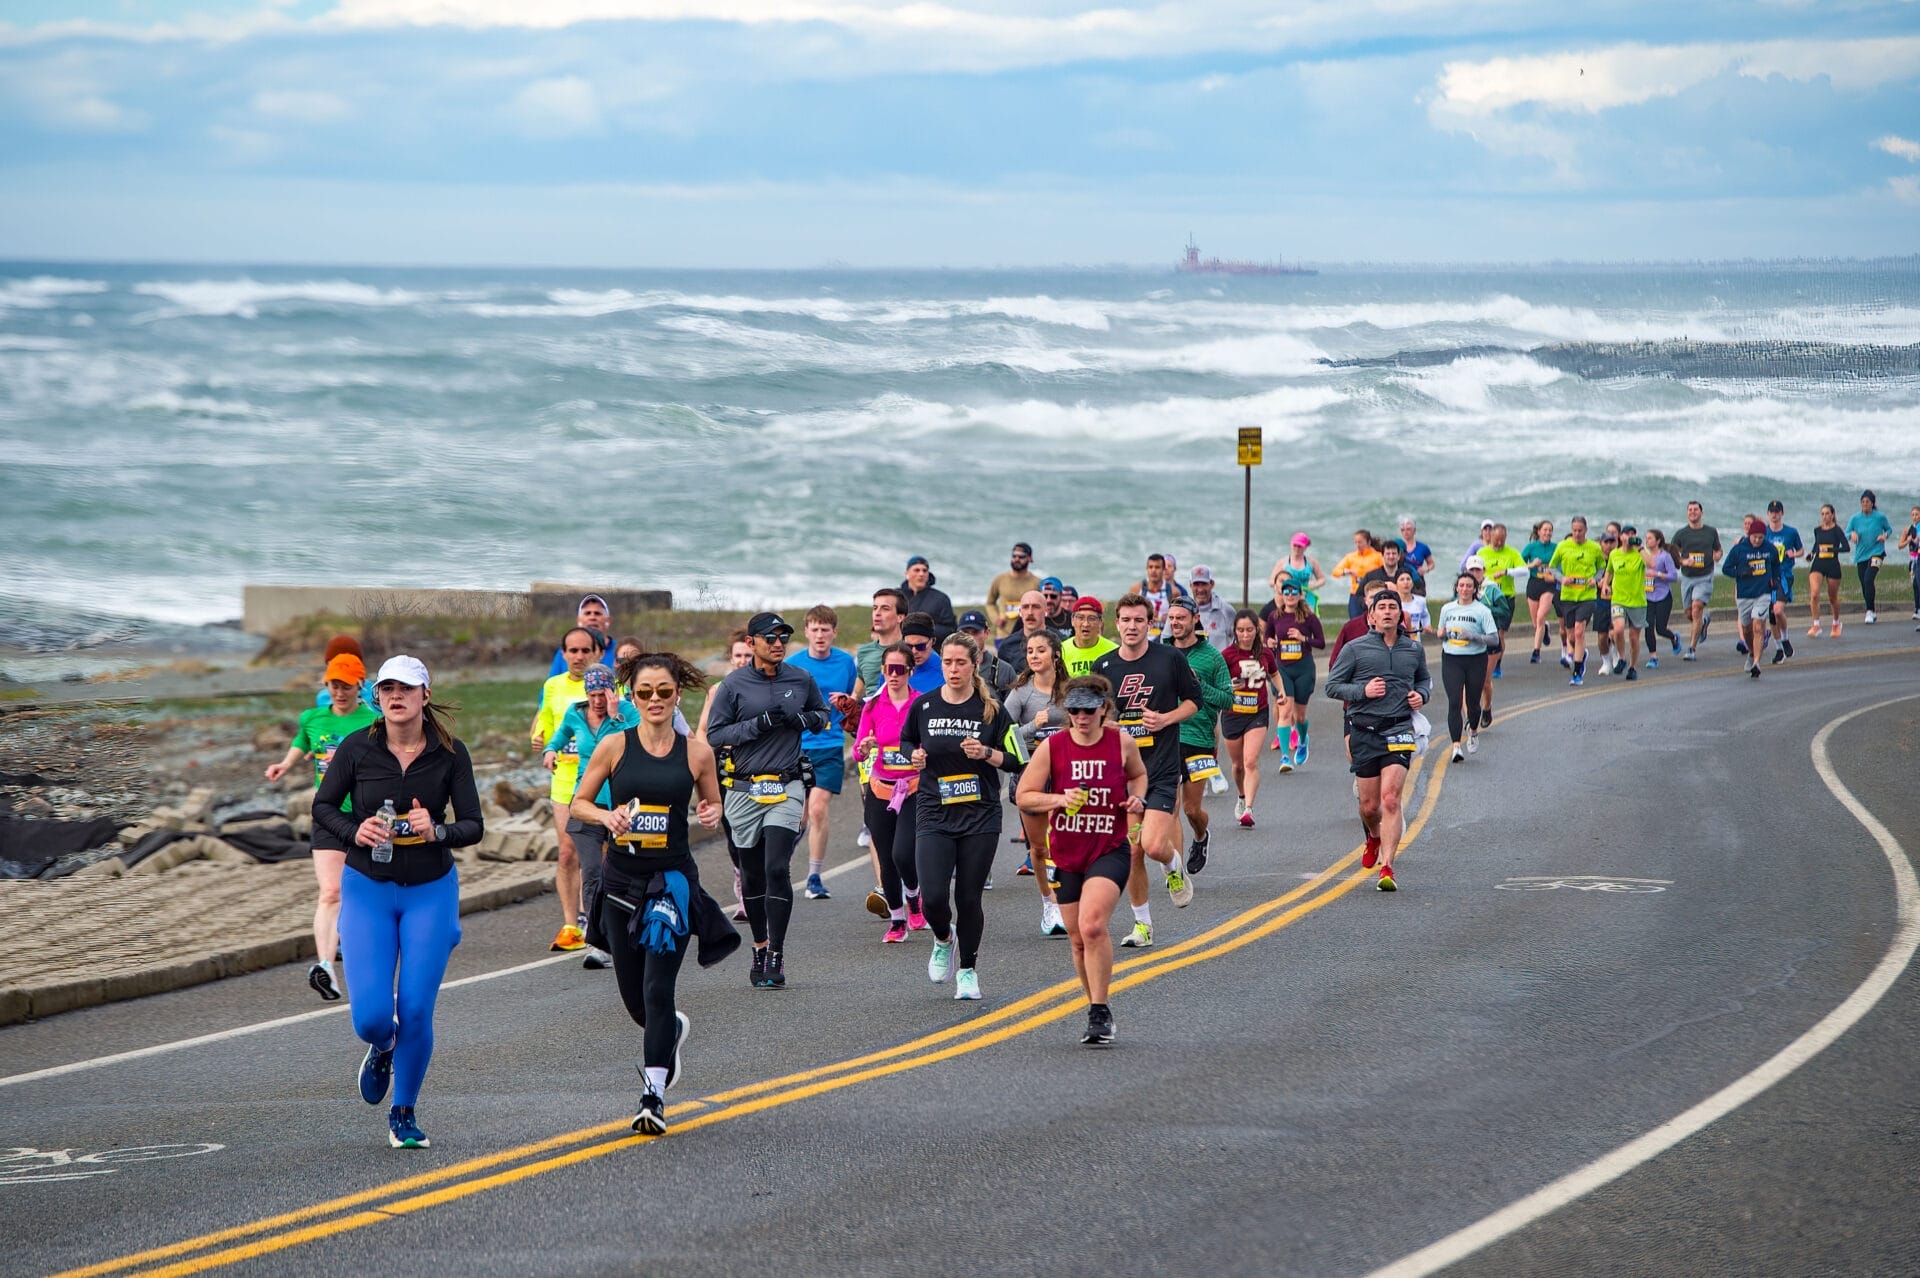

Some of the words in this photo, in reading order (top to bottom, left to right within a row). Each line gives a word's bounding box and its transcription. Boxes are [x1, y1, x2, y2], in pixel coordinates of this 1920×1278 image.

[1117, 673, 1154, 710] BC
[928, 718, 982, 731] BRYANT
[1070, 760, 1107, 780] BUT
[953, 781, 977, 795] 2065
[636, 815, 667, 831] 2903
[1055, 813, 1115, 834] COFFEE
